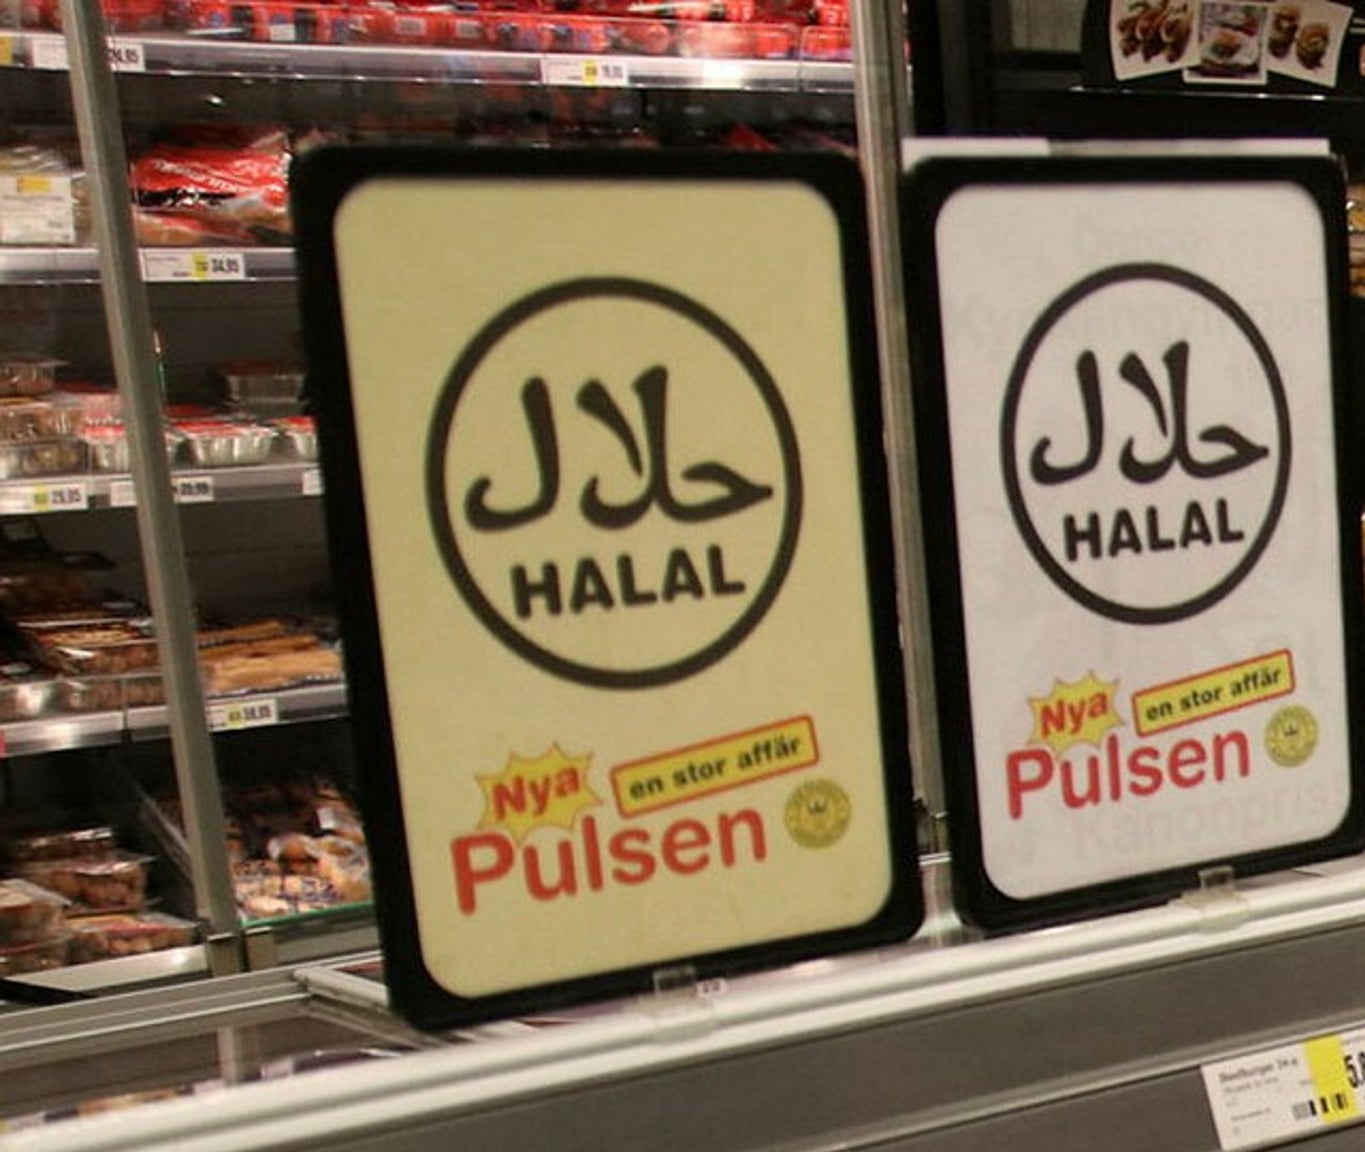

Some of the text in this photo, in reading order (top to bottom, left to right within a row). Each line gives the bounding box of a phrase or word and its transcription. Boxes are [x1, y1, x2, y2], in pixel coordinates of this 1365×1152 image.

[1029, 338, 1271, 486] حلال
[464, 365, 774, 533] حلال
[1062, 497, 1245, 563] HALAL
[510, 544, 747, 620] HALAL
[1038, 690, 1110, 738] Nya
[1146, 664, 1282, 722] en stor affär
[490, 765, 582, 822] Nya
[629, 733, 803, 802] en stor affär
[1005, 729, 1251, 820] Pulsen
[449, 807, 768, 917] Pulsen
